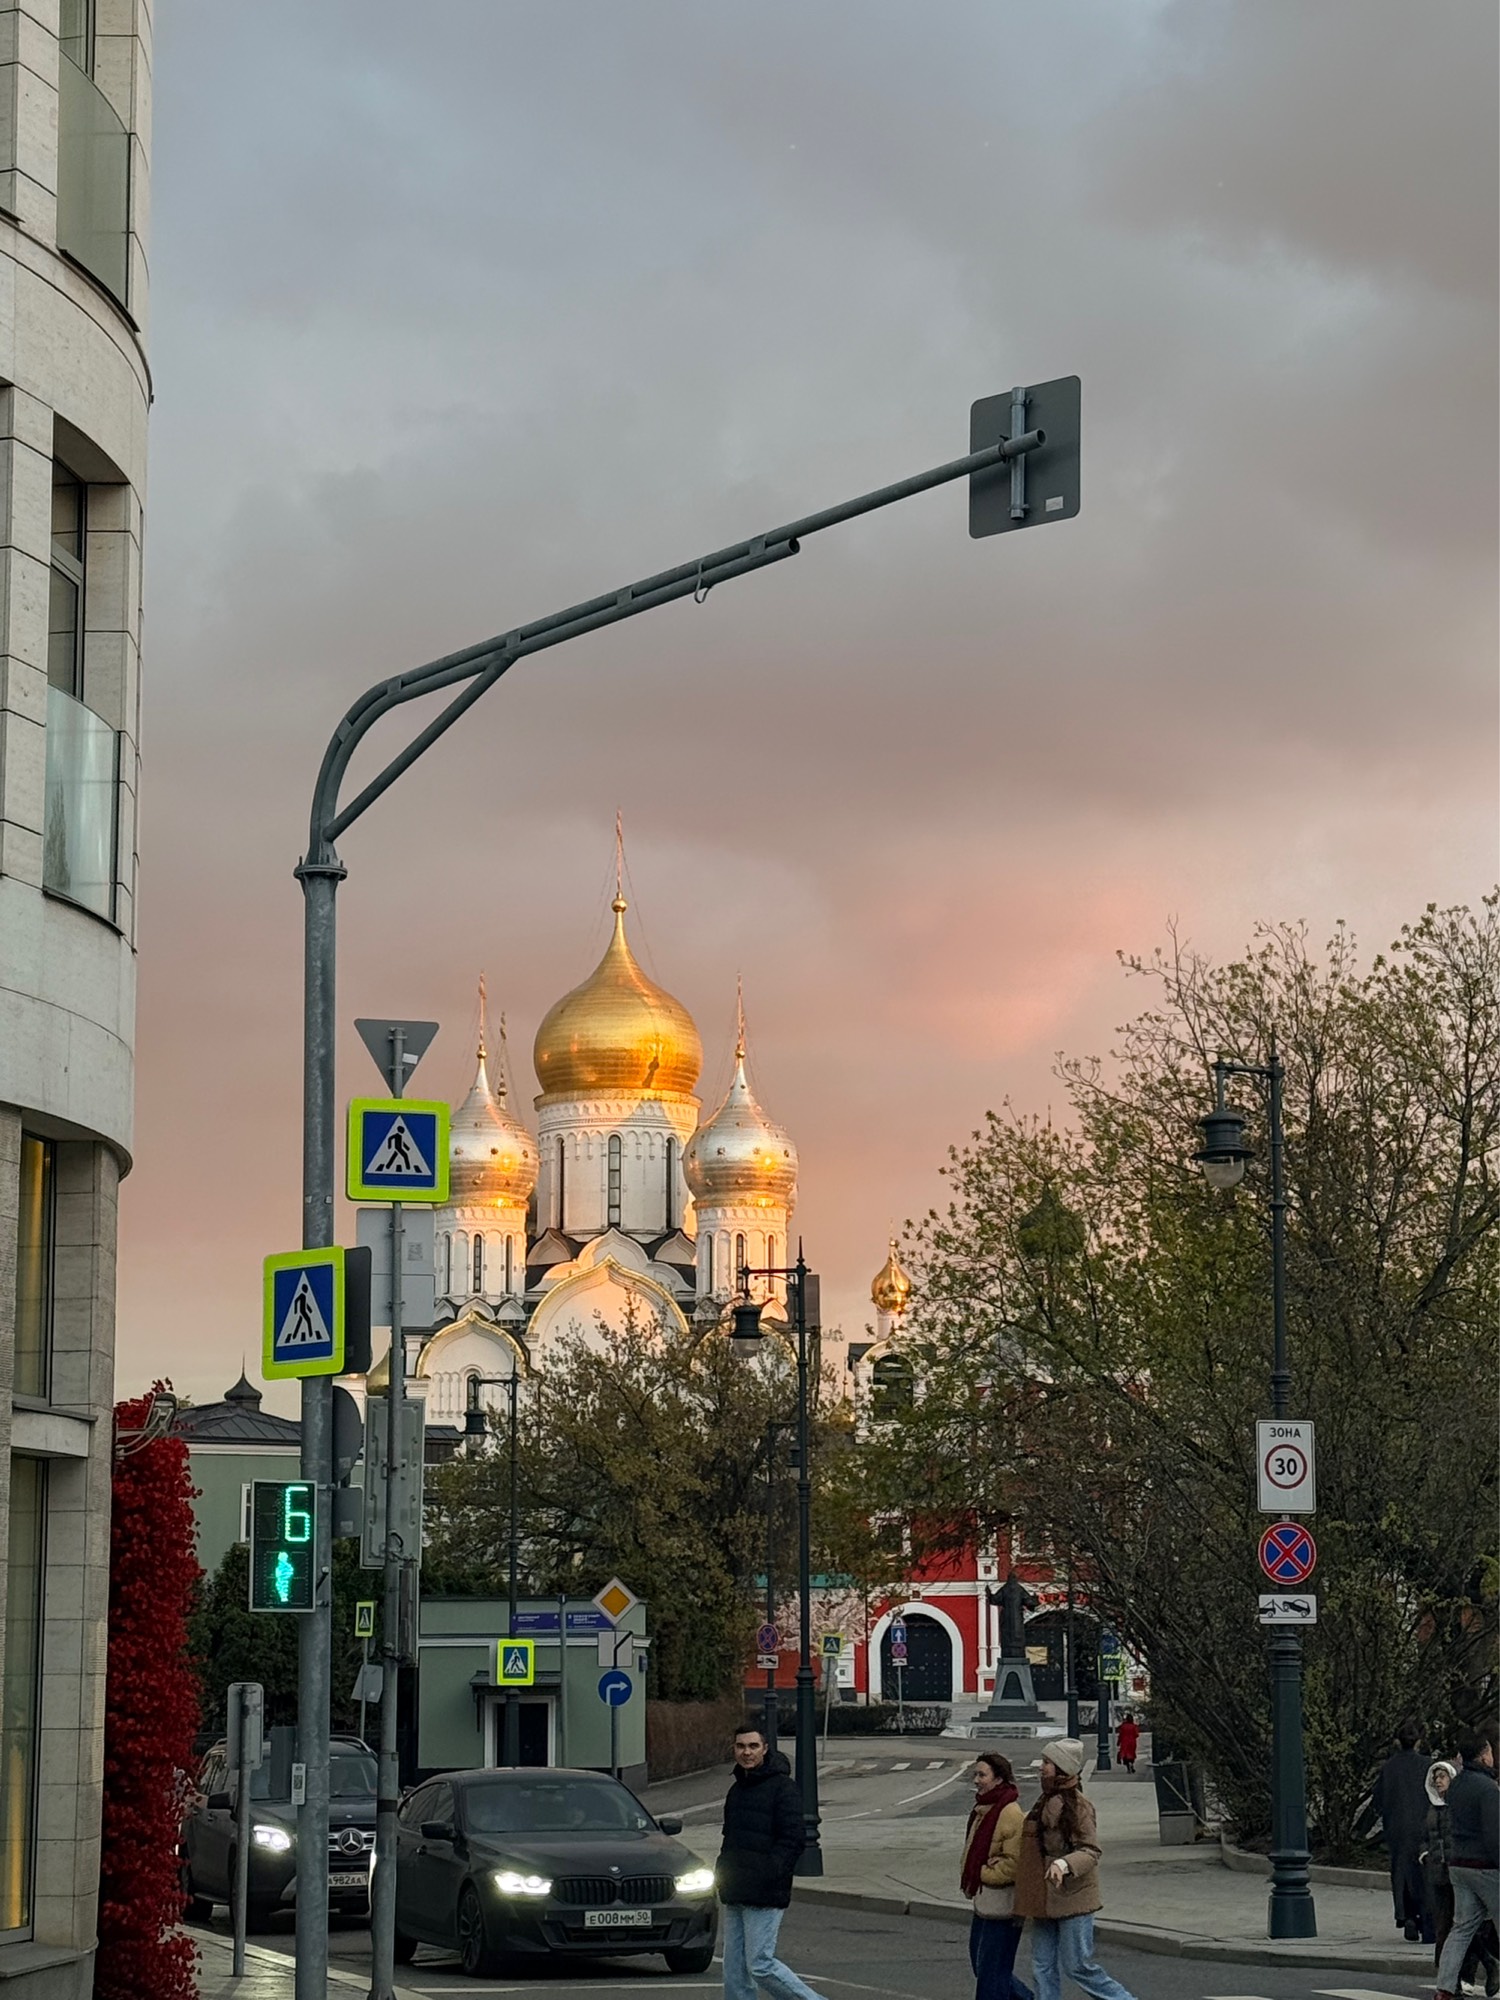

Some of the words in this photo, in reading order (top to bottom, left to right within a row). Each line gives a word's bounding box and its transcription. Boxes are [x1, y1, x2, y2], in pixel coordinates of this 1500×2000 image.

[1269, 1427, 1301, 1438] ЗОНА
[1275, 1458, 1297, 1476] 30
[285, 1486, 310, 1542] 6
